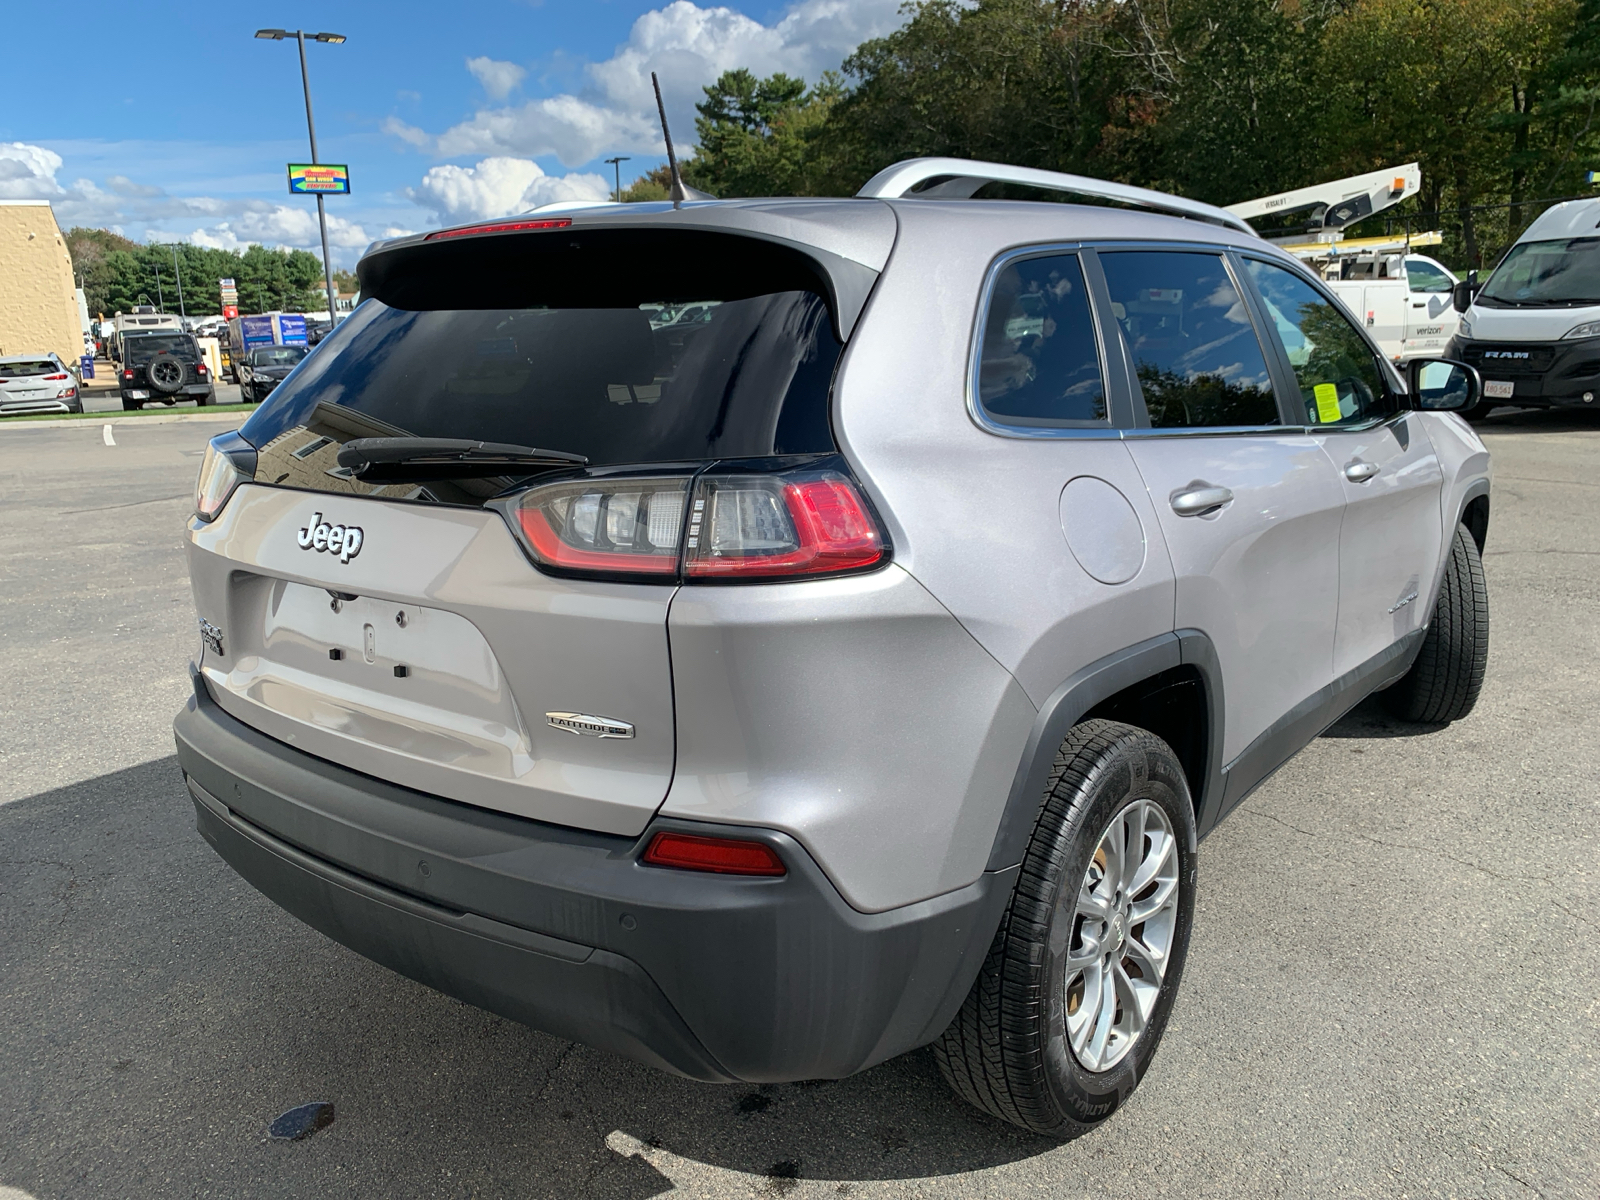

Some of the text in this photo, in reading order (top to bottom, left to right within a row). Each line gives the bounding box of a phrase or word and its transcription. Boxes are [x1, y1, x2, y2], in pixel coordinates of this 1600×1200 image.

[1264, 197, 1287, 209] VERSALIFT
[1416, 325, 1442, 335] verizon
[1485, 351, 1530, 359] RAM
[298, 512, 364, 565] Jeep
[551, 717, 608, 732] LATITUDE
